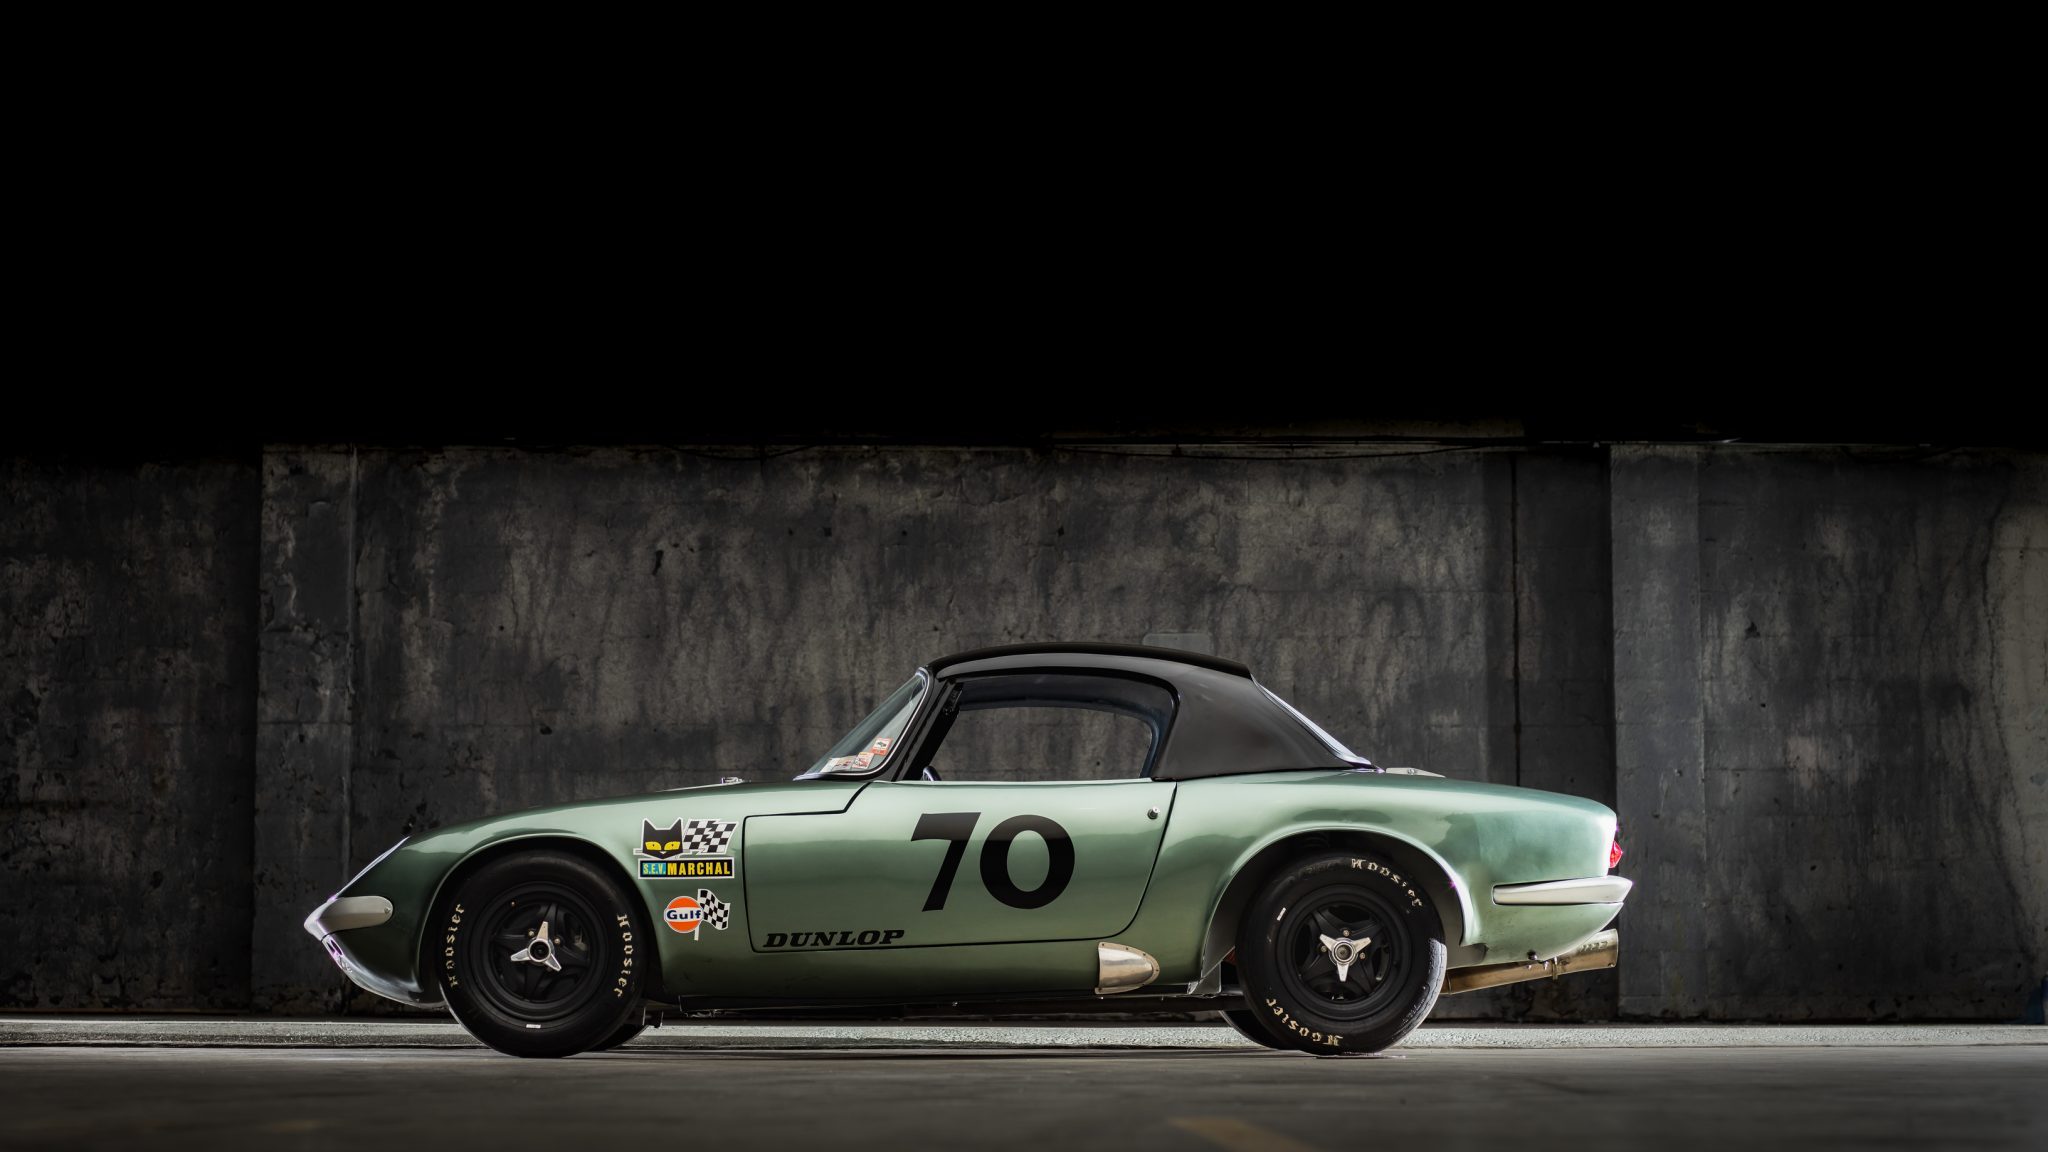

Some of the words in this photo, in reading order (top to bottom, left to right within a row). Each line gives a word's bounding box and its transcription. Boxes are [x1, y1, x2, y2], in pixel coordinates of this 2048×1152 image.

[643, 862, 666, 875] S.E.V.
[667, 862, 730, 875] MARCHAL
[910, 812, 1075, 912] 70
[666, 910, 702, 920] Gulf
[763, 929, 905, 948] DUNLOP
[445, 903, 465, 988] Hoosier
[614, 913, 634, 998] Hoosier
[1265, 998, 1344, 1047] Hoosier
